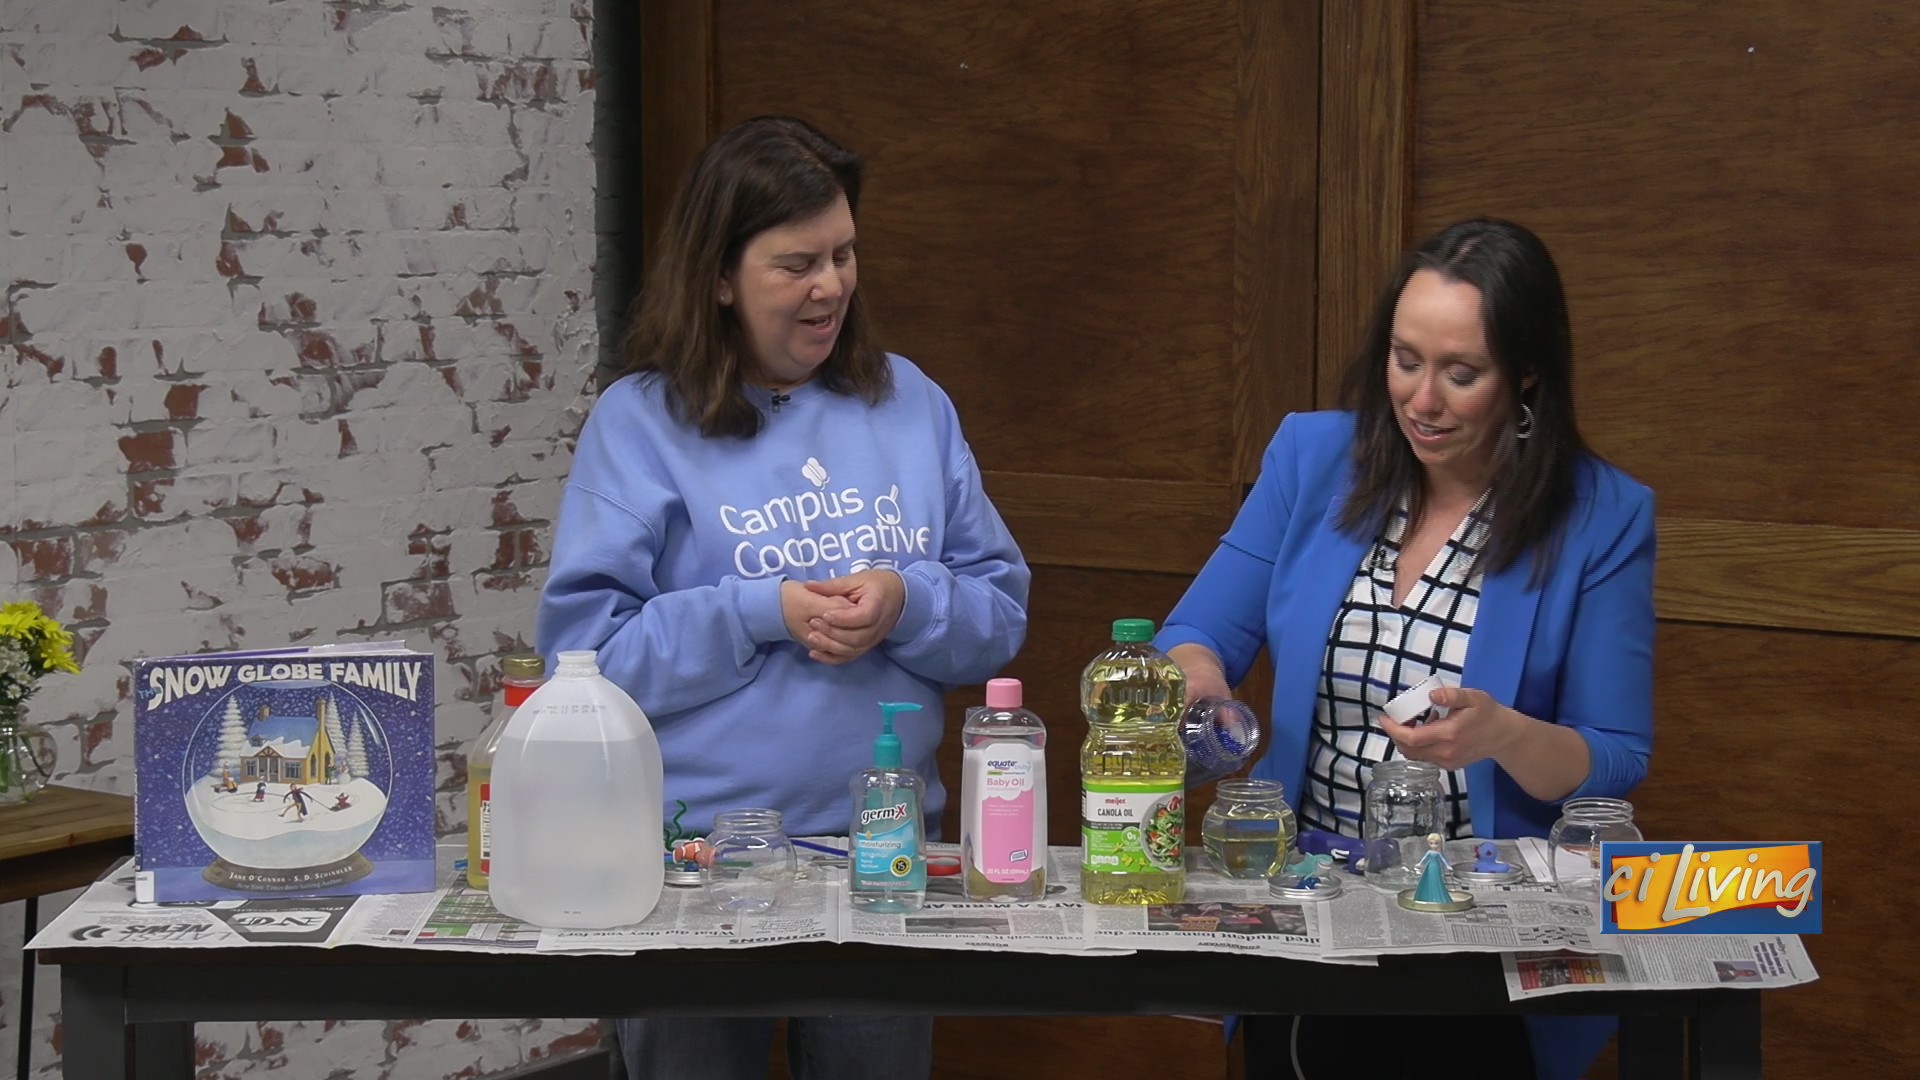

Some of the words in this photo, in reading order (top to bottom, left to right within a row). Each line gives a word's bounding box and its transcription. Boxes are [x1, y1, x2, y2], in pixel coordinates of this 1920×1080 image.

[720, 487, 864, 535] Campus
[734, 514, 931, 578] Cooperative
[147, 665, 233, 711] SNOW
[237, 663, 324, 683] GLOBE
[330, 661, 422, 702] FAMILY
[987, 760, 1018, 769] equate
[986, 777, 1010, 787] Baby
[1011, 778, 1025, 786] Oil
[1105, 797, 1126, 805] meijer
[861, 803, 907, 825] germ-X
[1097, 808, 1122, 817] CANOLA
[1123, 808, 1133, 817] OIL
[860, 841, 902, 849] moisturizing
[860, 851, 889, 859] original
[229, 872, 247, 880] JANE
[248, 875, 286, 883] O'CONNOR
[315, 865, 353, 879] SCHINDLER
[119, 923, 213, 934] NEWS
[112, 931, 232, 942] LATEST
[728, 932, 827, 944] OPINIONS
[1221, 932, 1280, 942] student
